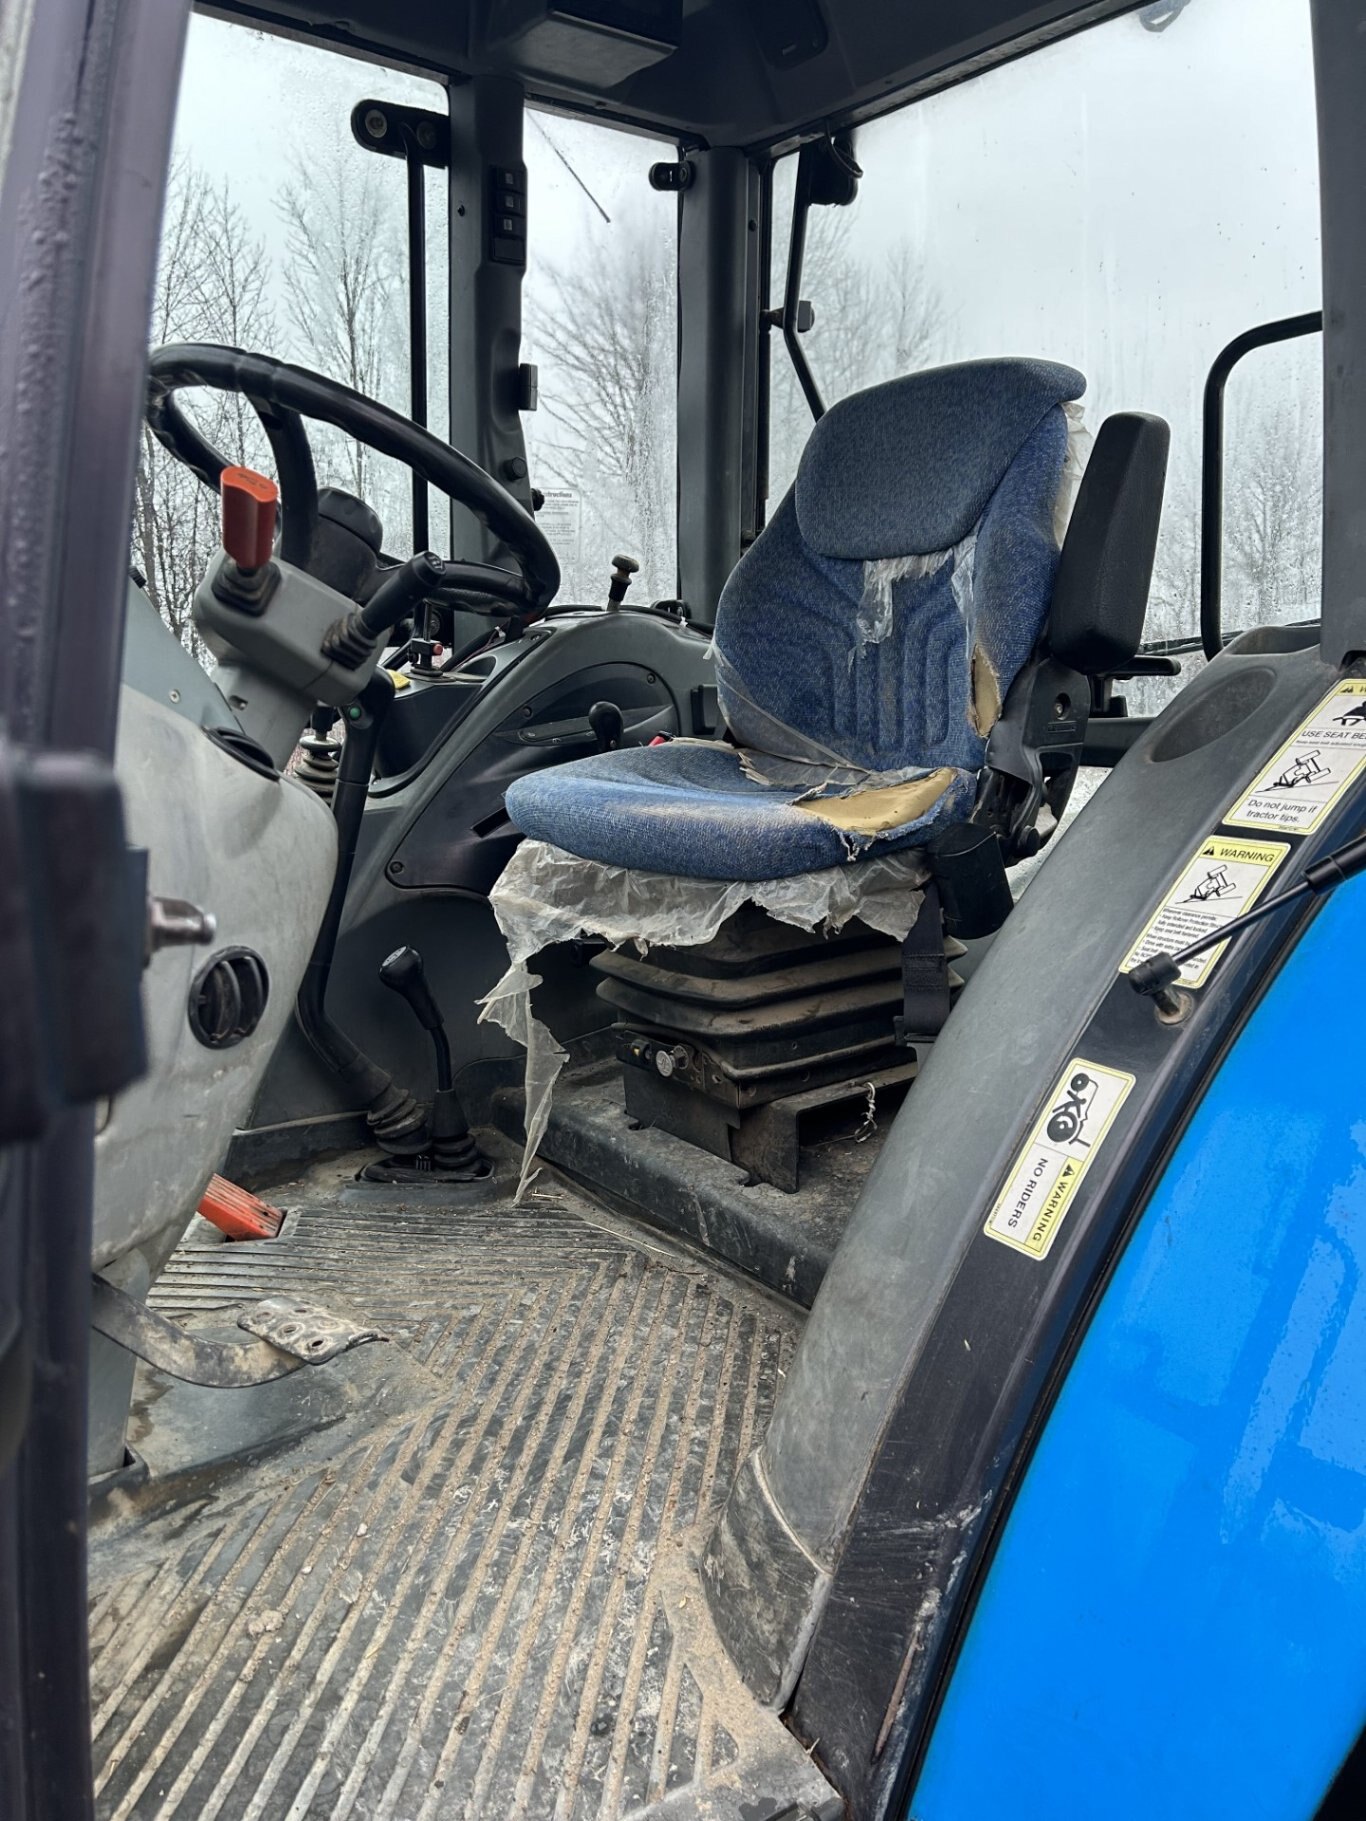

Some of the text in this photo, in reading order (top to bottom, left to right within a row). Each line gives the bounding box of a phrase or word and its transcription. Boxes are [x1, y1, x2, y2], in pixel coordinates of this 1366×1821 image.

[1302, 730, 1323, 738] USE
[1351, 732, 1366, 740] BE
[1248, 799, 1318, 813] Do not jump if
[1246, 810, 1300, 822] tractor tips.
[1219, 847, 1275, 862] WARNING
[1008, 1158, 1048, 1228] NO RIDERS
[1032, 1181, 1068, 1242] WARNING
